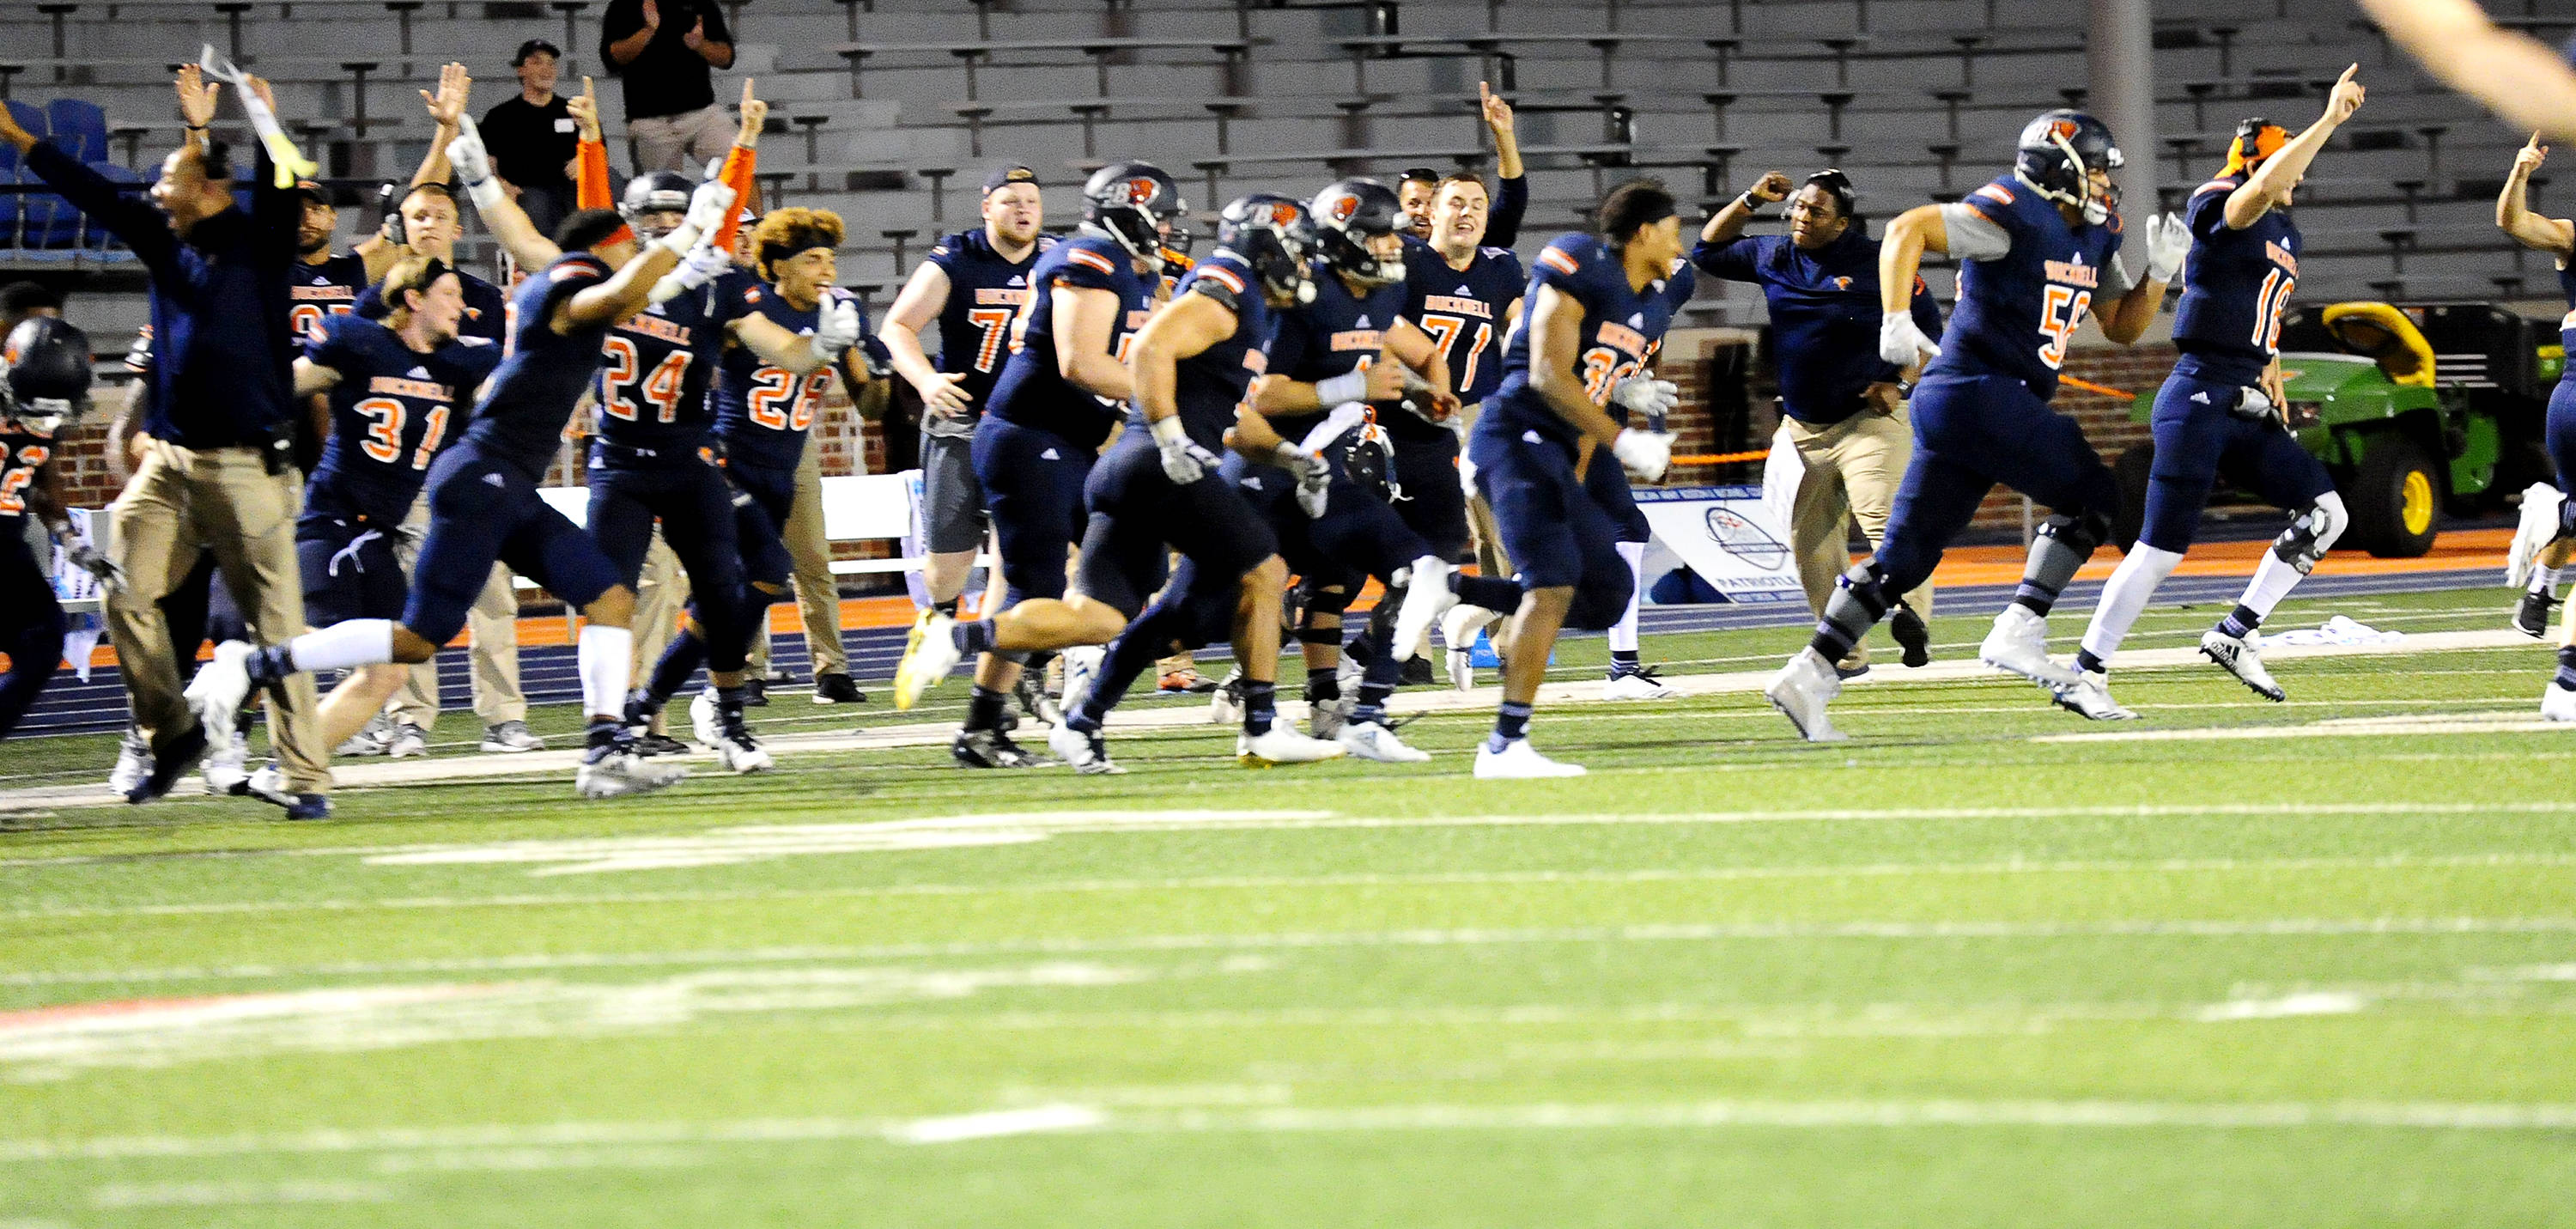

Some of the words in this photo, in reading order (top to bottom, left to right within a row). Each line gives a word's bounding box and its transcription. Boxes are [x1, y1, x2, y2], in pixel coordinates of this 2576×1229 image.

[975, 288, 1027, 305] BUCKN
[2044, 259, 2098, 289] BUCKNELL
[1425, 295, 1493, 319] BUCKNELL
[2251, 267, 2295, 355] 18
[1420, 313, 1492, 392] 71
[369, 376, 454, 403] BUCKNELL
[601, 335, 694, 423] 24
[353, 397, 451, 471] 31
